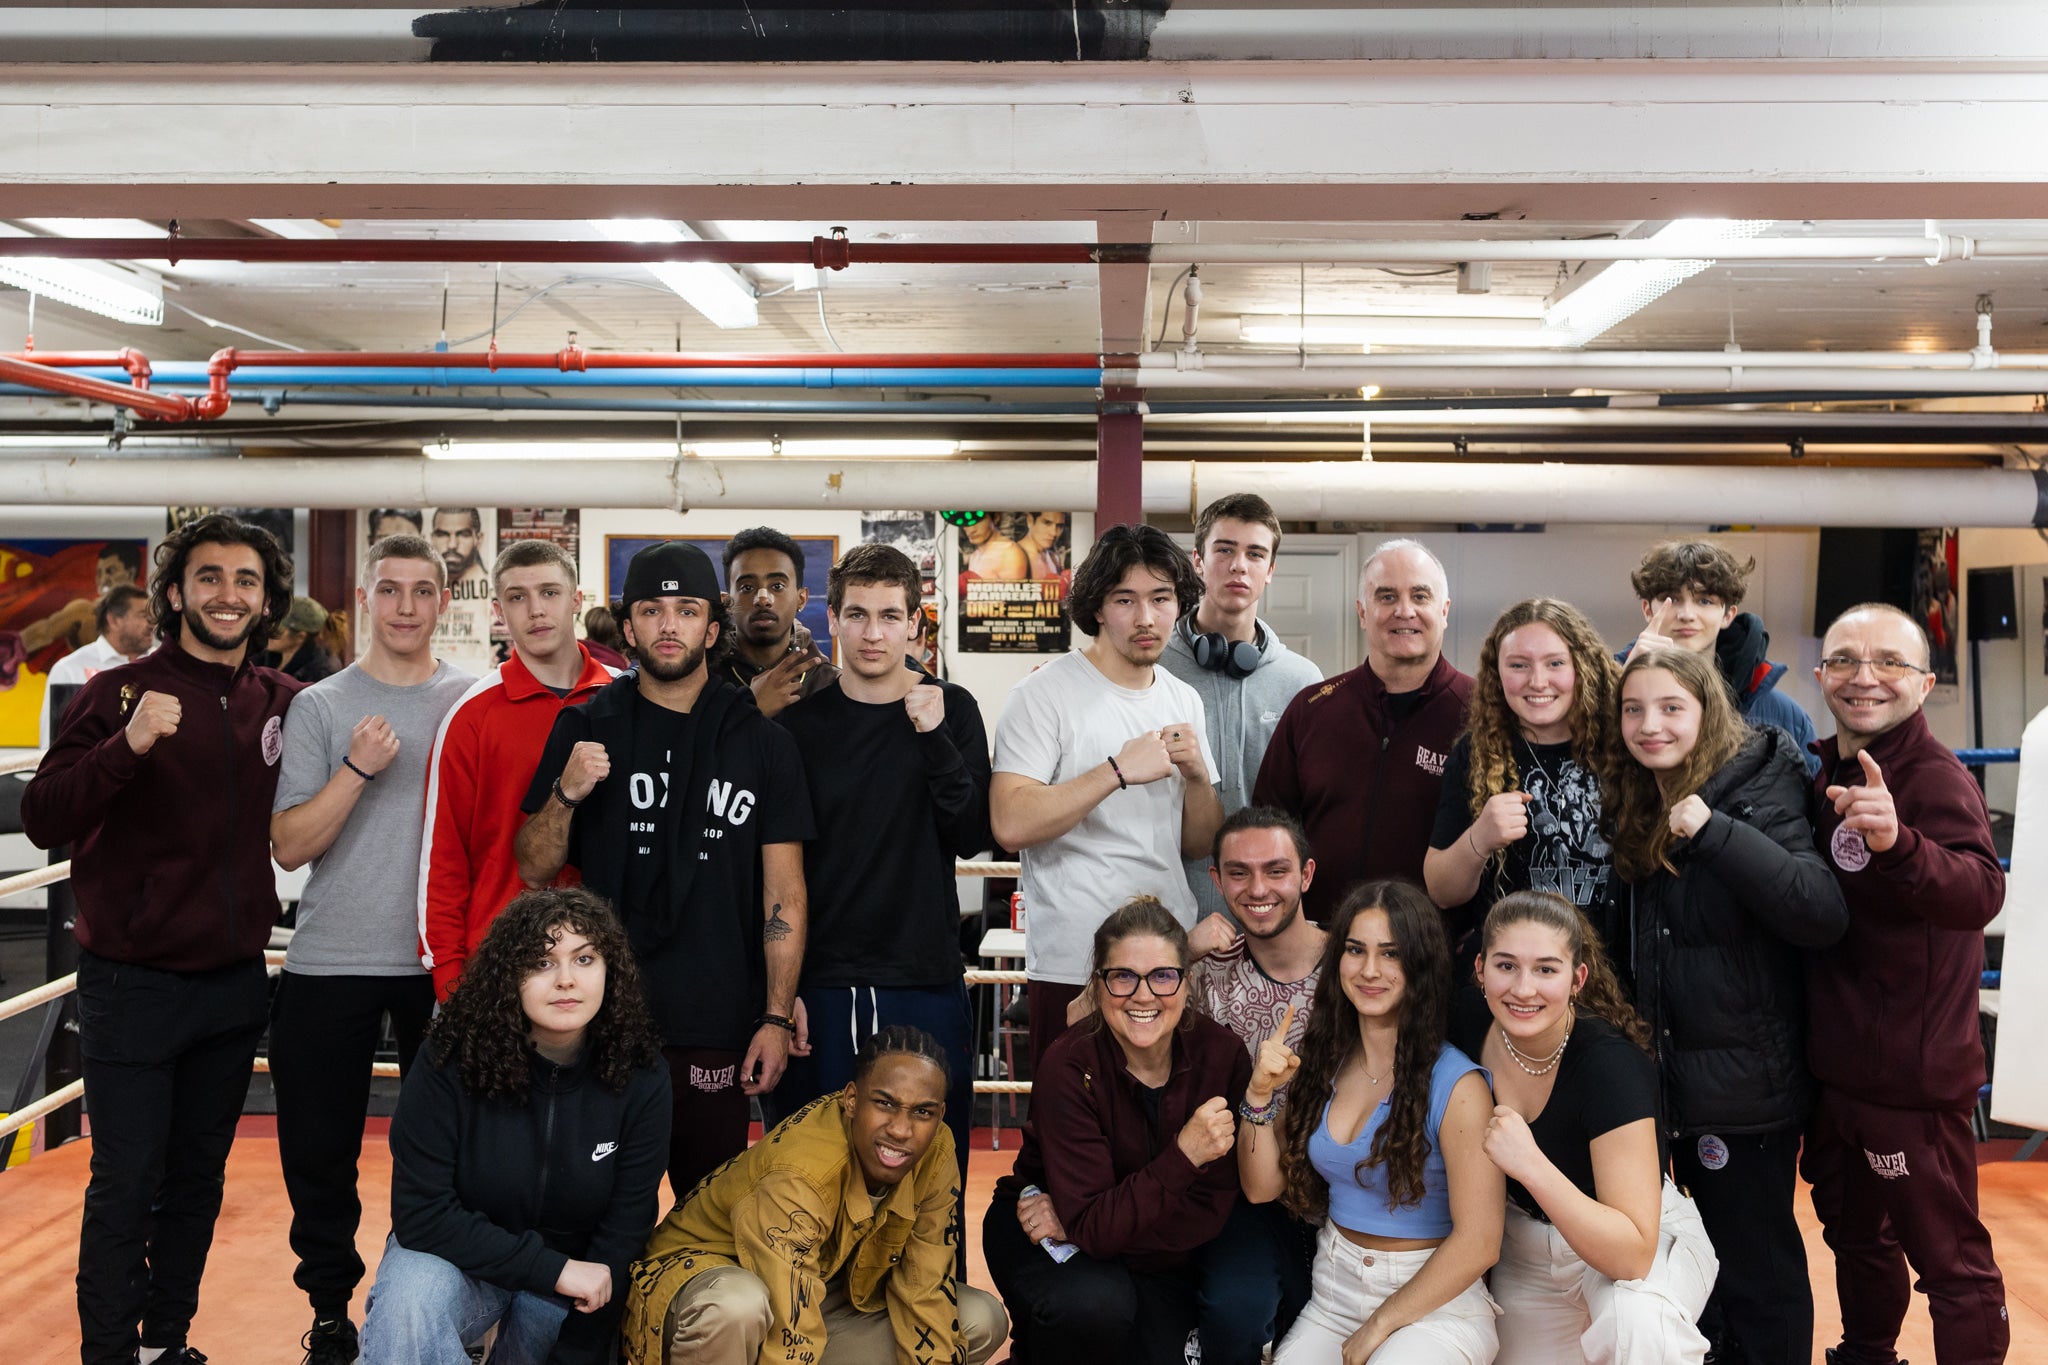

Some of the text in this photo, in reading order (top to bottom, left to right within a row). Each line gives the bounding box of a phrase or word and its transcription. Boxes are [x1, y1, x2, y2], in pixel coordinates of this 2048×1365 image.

[447, 579, 489, 600] GULO
[966, 583, 1042, 592] MORALES
[966, 592, 1042, 601] BARRERA
[966, 601, 1007, 618] ONCE
[1034, 602, 1061, 618] ALL
[1416, 745, 1448, 766] BEAV
[1423, 763, 1445, 774] BOXIN
[629, 822, 655, 832] MSM
[690, 1064, 735, 1086] BEAVER
[596, 1141, 615, 1153] NIKE
